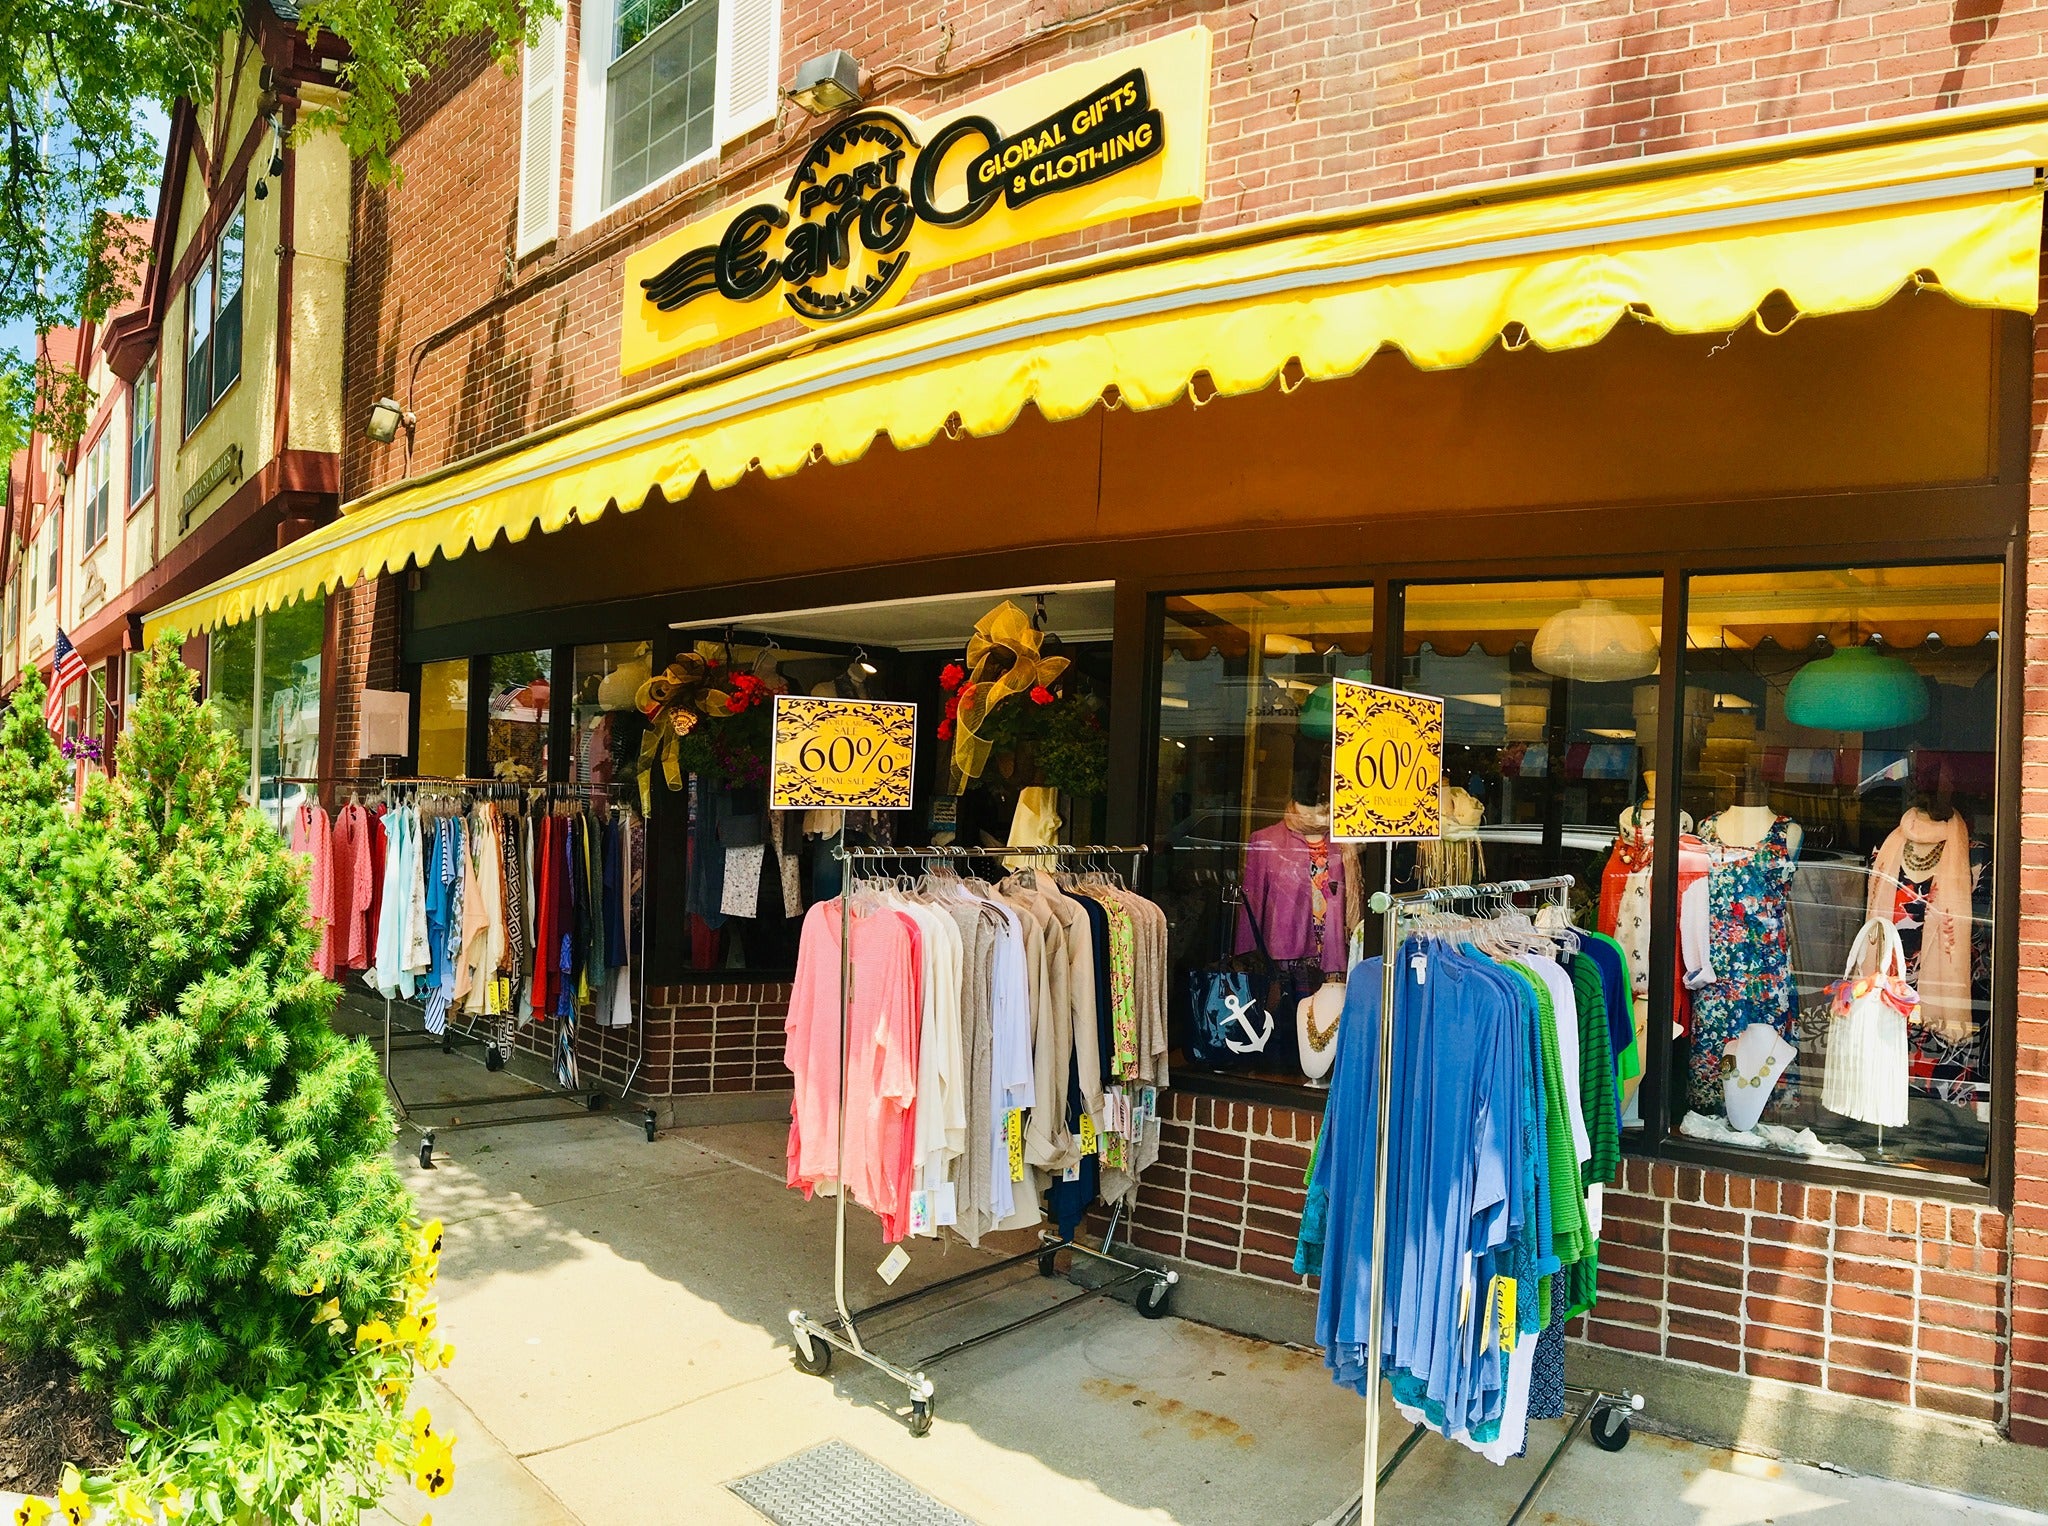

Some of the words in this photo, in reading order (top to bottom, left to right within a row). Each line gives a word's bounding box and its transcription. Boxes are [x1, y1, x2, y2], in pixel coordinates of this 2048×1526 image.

[978, 123, 1067, 183] GLOBAL
[1071, 80, 1138, 136] GIFTS
[1012, 175, 1027, 194] &
[1029, 122, 1153, 187] CLOTHING
[799, 149, 907, 219] PORT
[799, 735, 894, 775] 60%
[834, 727, 857, 736] SALE
[895, 753, 909, 761] OFF
[1355, 737, 1428, 792] 60%
[821, 777, 844, 785] FINAL
[847, 778, 867, 786] SALE
